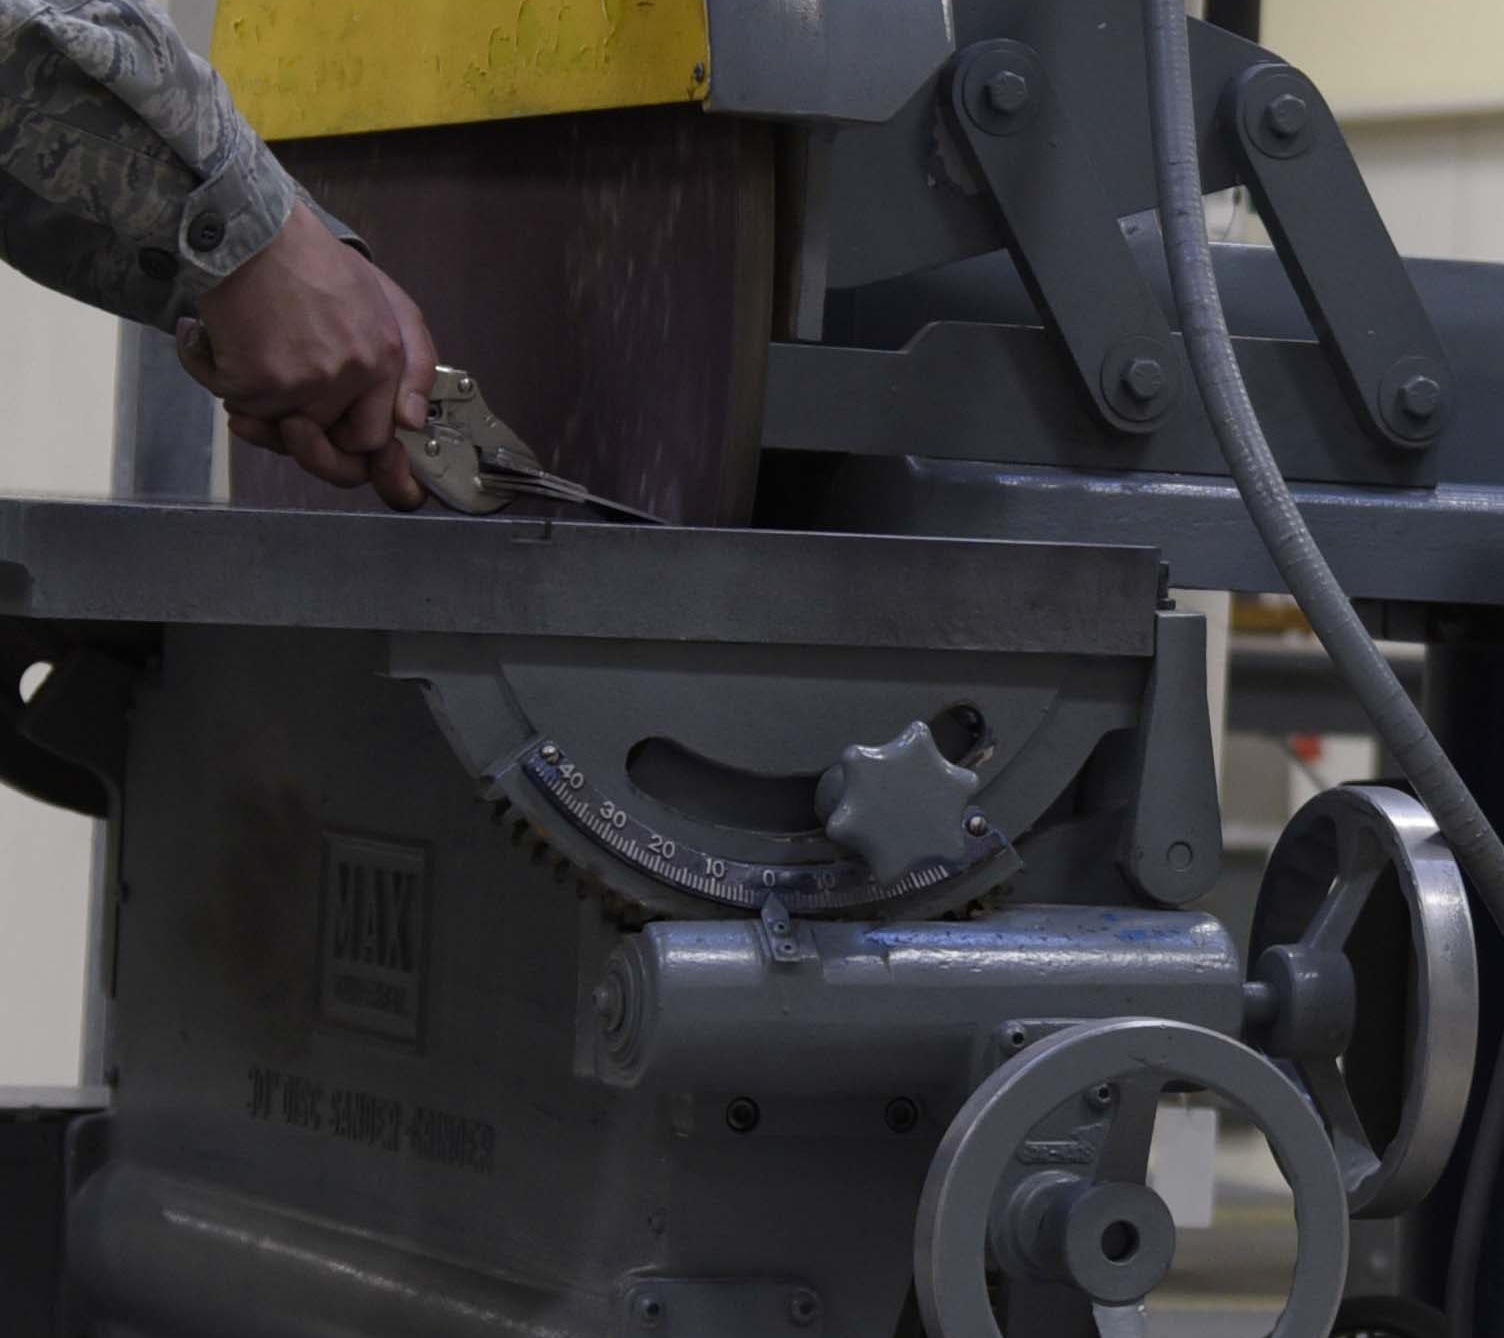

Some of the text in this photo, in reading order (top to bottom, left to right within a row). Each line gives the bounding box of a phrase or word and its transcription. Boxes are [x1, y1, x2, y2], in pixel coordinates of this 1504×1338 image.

[558, 762, 585, 791] 40
[599, 800, 626, 830] 30
[648, 834, 676, 859] 20
[705, 856, 726, 878] 10
